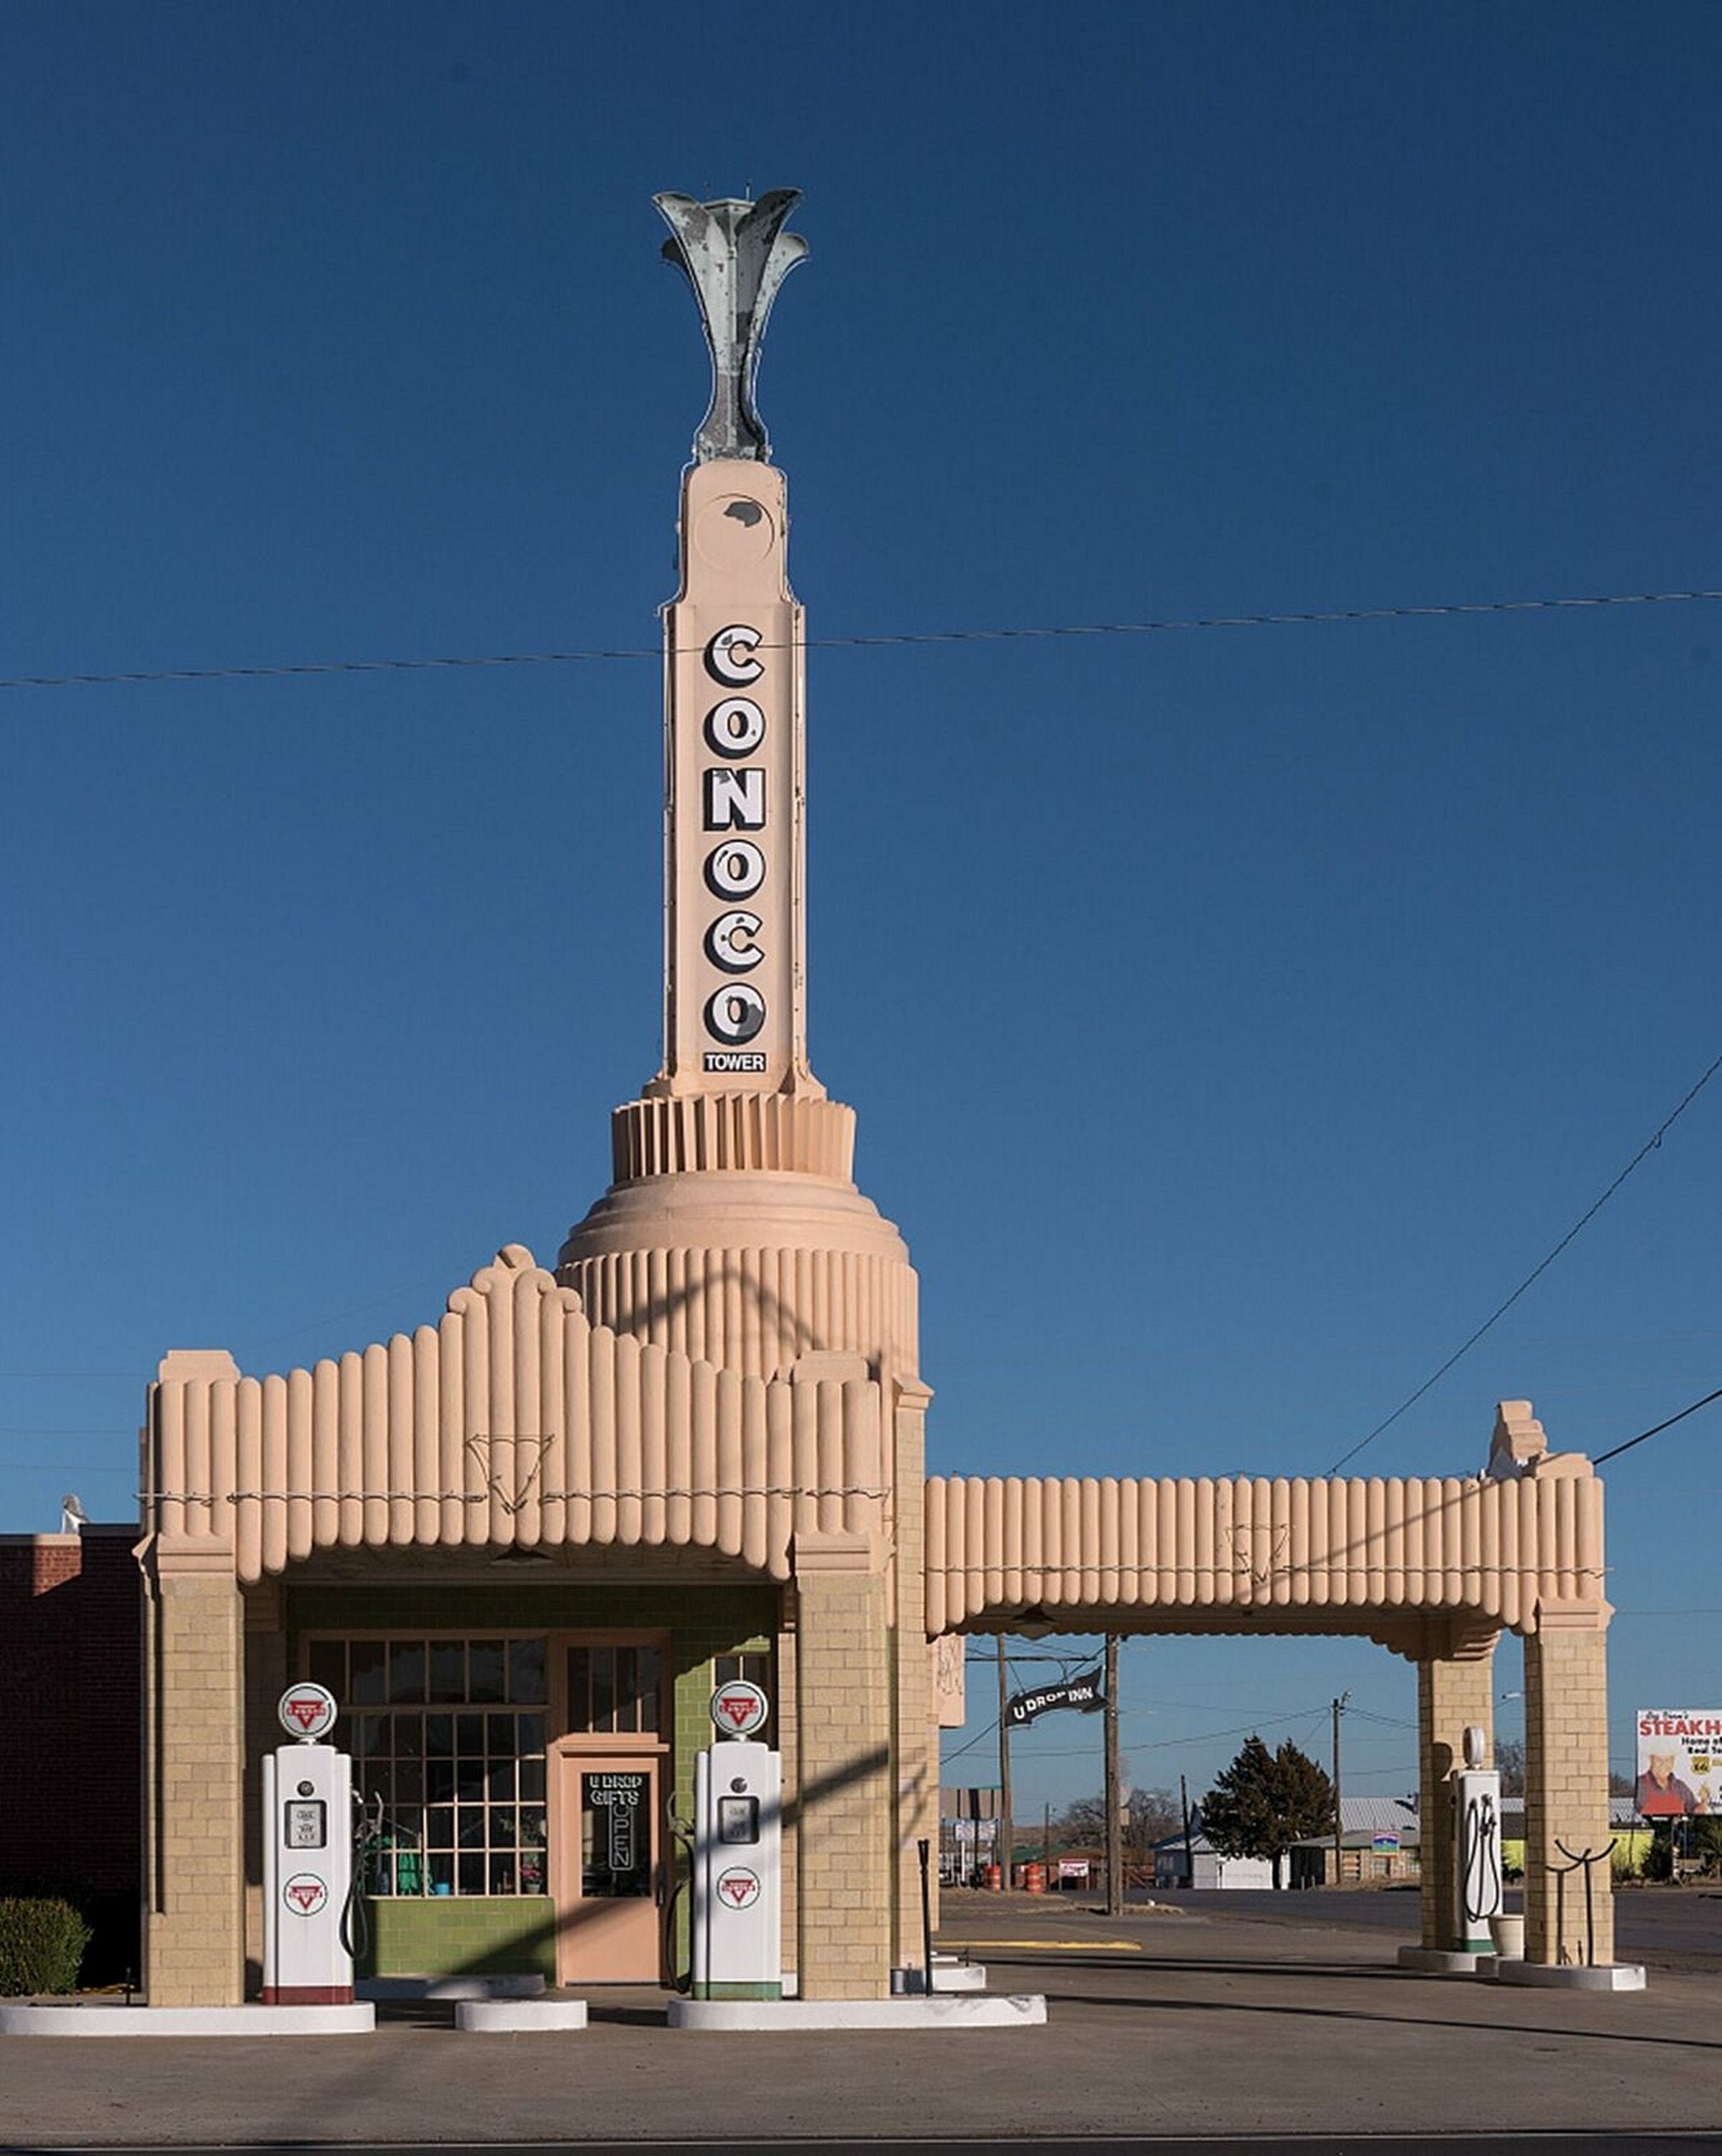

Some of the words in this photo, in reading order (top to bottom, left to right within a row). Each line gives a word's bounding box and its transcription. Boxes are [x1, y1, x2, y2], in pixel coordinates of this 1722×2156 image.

[703, 623, 765, 1047] CONOCO
[705, 1054, 765, 1070] TOWER
[1013, 1705, 1027, 1720] U
[1067, 1686, 1093, 1703] INN
[1639, 1719, 1722, 1736] STEAKH
[590, 1789, 640, 1805] GIFTS
[613, 1802, 630, 1866] OPEN
